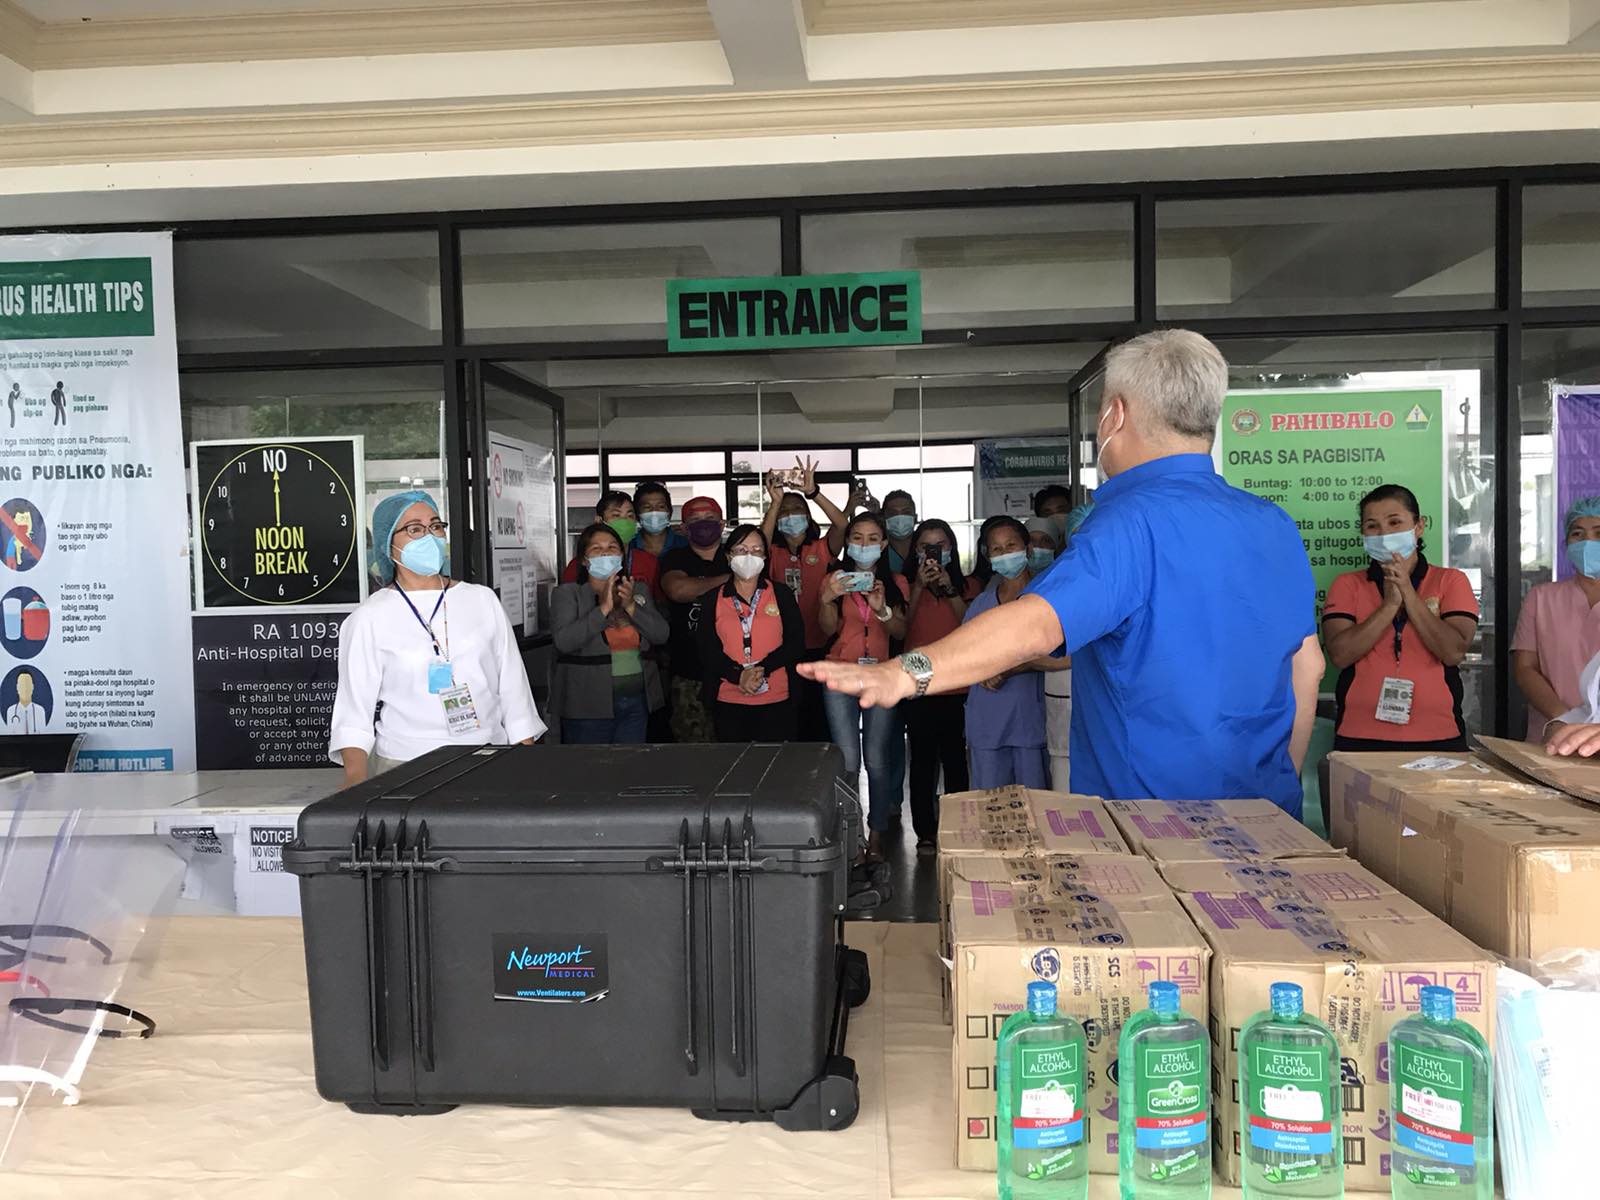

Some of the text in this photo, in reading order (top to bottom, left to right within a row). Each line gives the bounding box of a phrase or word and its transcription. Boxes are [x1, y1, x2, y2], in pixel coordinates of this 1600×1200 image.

[0, 281, 144, 316] US HEALTH TIPS
[679, 284, 908, 339] ENTRANCE
[1271, 411, 1395, 432] PAHIBALO
[263, 449, 287, 473] NO
[1004, 455, 1055, 469] CORONAVIRUS
[1229, 448, 1385, 466] ORAS SA PAGBISITA
[237, 462, 247, 474] 11
[307, 460, 313, 471] 1
[32, 464, 105, 480] PUBLIKO
[111, 464, 152, 479] NGA:
[329, 483, 336, 495] 2
[1244, 476, 1383, 490] Buntag: 10:00 to 12:00
[217, 486, 228, 498] 10
[1302, 491, 1345, 502] 4:00 to
[86, 523, 98, 531] ang
[209, 519, 215, 531] 9
[340, 515, 347, 527] 3
[1318, 518, 1351, 530] ubos
[70, 533, 81, 541] nga
[83, 533, 95, 541] nay
[255, 526, 305, 551] NOON
[58, 543, 86, 552] og sipon
[220, 557, 227, 569] 8
[255, 551, 309, 576] BREAK
[332, 554, 339, 566] 4
[1311, 556, 1327, 566] sa
[81, 583, 90, 591] og
[243, 577, 249, 589] 7
[312, 575, 319, 587] 5
[278, 584, 285, 596] 6
[61, 593, 76, 601] baso
[61, 604, 99, 612] tubig matag
[62, 624, 102, 633] pag luto ang
[253, 623, 281, 640] RA
[62, 634, 90, 643] pagkaon
[197, 645, 304, 662] Anti-Hospital
[67, 669, 90, 678] magpa
[123, 678, 149, 687] hospital
[222, 682, 233, 692] In
[237, 681, 293, 693] emergency
[297, 682, 308, 690] or
[65, 689, 85, 697] health
[85, 689, 105, 697] center
[114, 689, 136, 698] inyong
[136, 689, 154, 698] lugar
[239, 693, 247, 703] it
[250, 693, 274, 703] shall
[277, 693, 290, 702] be
[65, 700, 81, 709] kung
[82, 700, 105, 708] adunay
[79, 711, 88, 719] og
[88, 710, 108, 718] sip-on
[138, 710, 156, 718] kung
[229, 706, 248, 717] any
[252, 705, 292, 716] hospital
[296, 706, 306, 714] or
[66, 721, 78, 730] nag
[79, 720, 98, 729] byahe
[107, 720, 131, 728] Wuhan,
[131, 719, 154, 728] China)
[235, 716, 329, 729] to request, solicit,
[249, 730, 320, 740] or accept any
[259, 740, 324, 752] or any other
[75, 757, 166, 771] HD-NM HOTLINE
[255, 753, 312, 763] of advance
[252, 830, 293, 843] NOTICE
[252, 846, 263, 858] NO
[507, 944, 592, 978] Newport
[1107, 957, 1121, 978] SCS
[1178, 960, 1189, 976] 4
[549, 970, 596, 978] MEDICAL
[1455, 976, 1469, 992] 4
[1122, 996, 1130, 1006] DO
[1112, 1004, 1120, 1016] THIS
[1352, 996, 1361, 1021] DO NOT
[1101, 1005, 1110, 1037] DESTROYED
[1038, 1051, 1066, 1064] ETHYL
[1161, 1052, 1190, 1064] ETHYL
[1273, 1054, 1306, 1066] ETHYL
[1030, 1060, 1072, 1073] ALCOHOL
[1153, 1061, 1196, 1074] ALCOHOL
[1264, 1063, 1315, 1077] ALCOHOL
[1413, 1055, 1445, 1073] ETHYL
[1406, 1063, 1455, 1084] ALCOHOL
[1150, 1094, 1198, 1108] GreenCross
[1035, 1120, 1048, 1128] 70%
[1157, 1118, 1194, 1128] 70% Solution
[1271, 1121, 1313, 1133] 70% Solution
[1411, 1121, 1452, 1141] 70% Solution
